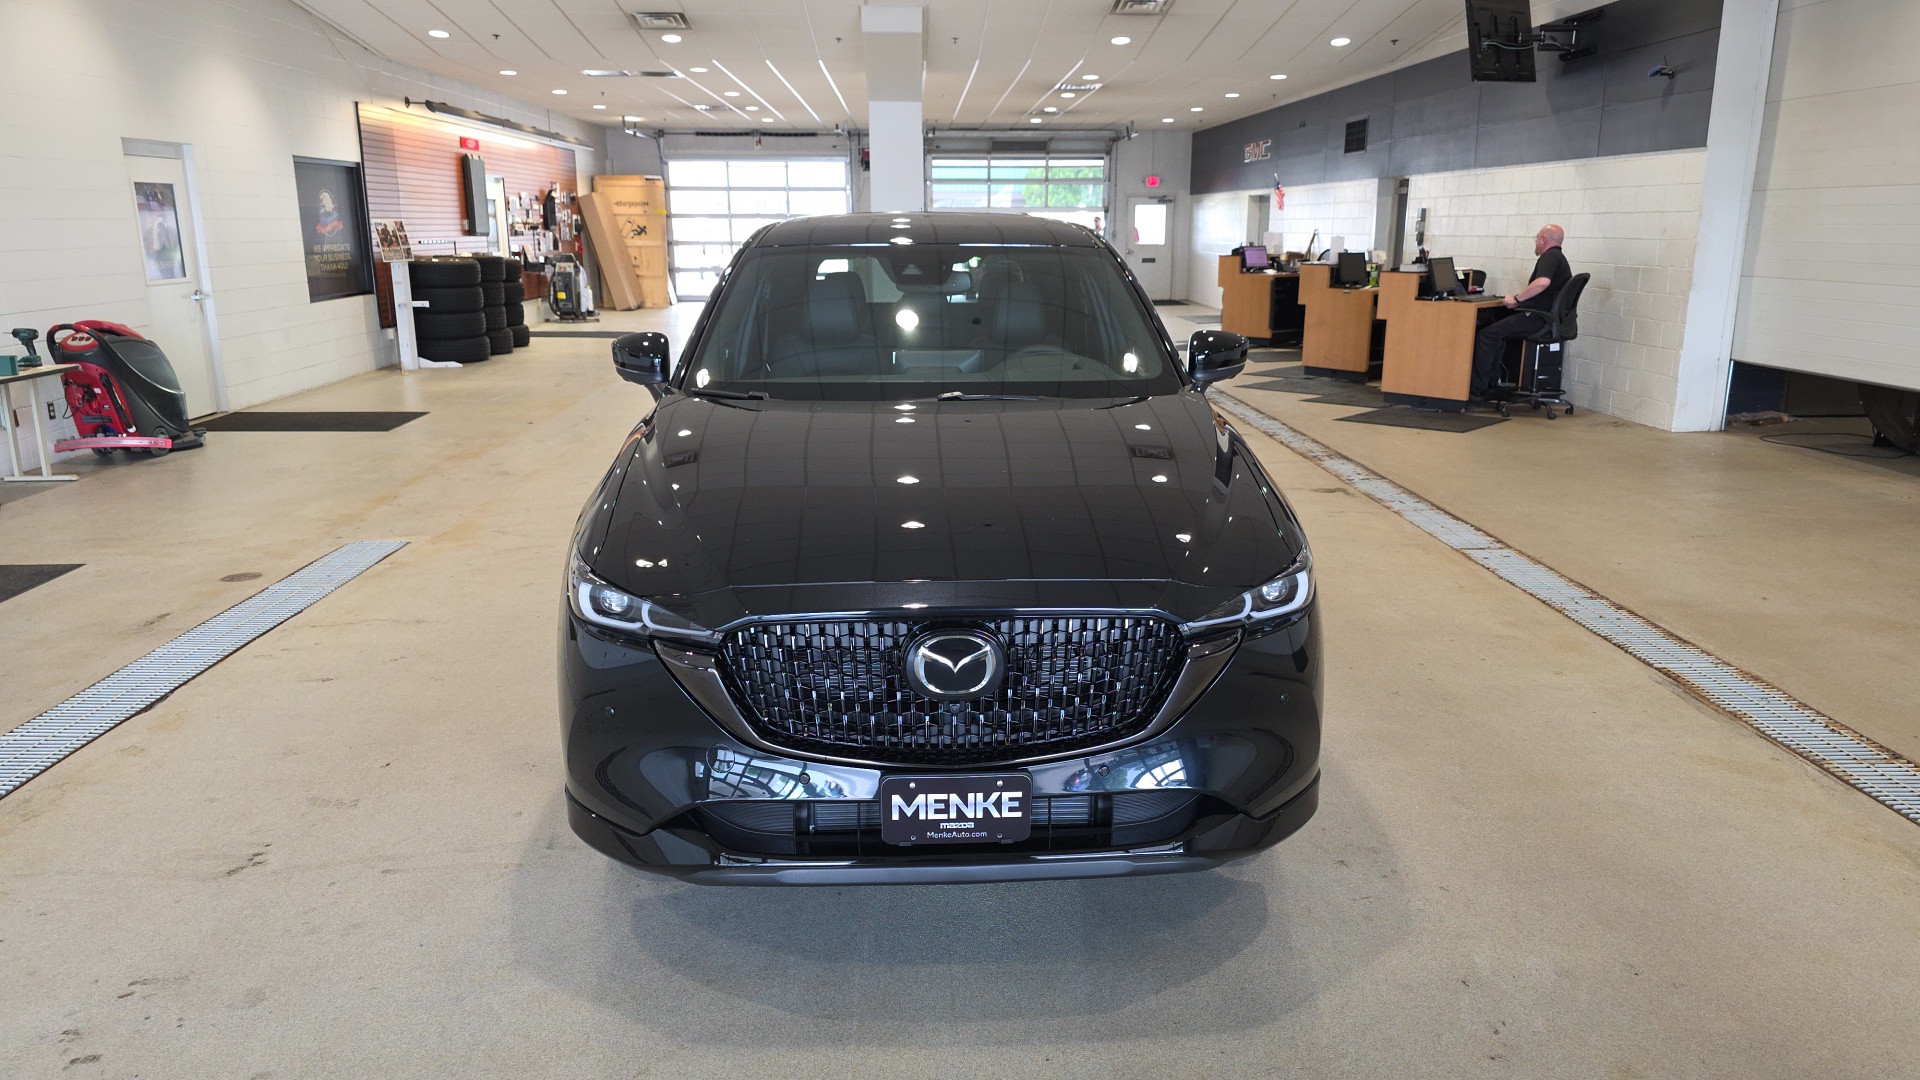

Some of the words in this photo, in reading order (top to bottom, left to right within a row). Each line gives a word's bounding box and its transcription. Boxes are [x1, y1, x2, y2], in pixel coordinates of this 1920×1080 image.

[1244, 140, 1271, 162] GMC
[891, 791, 1023, 820] MENKE
[926, 831, 988, 839] MenkeAuto.com
